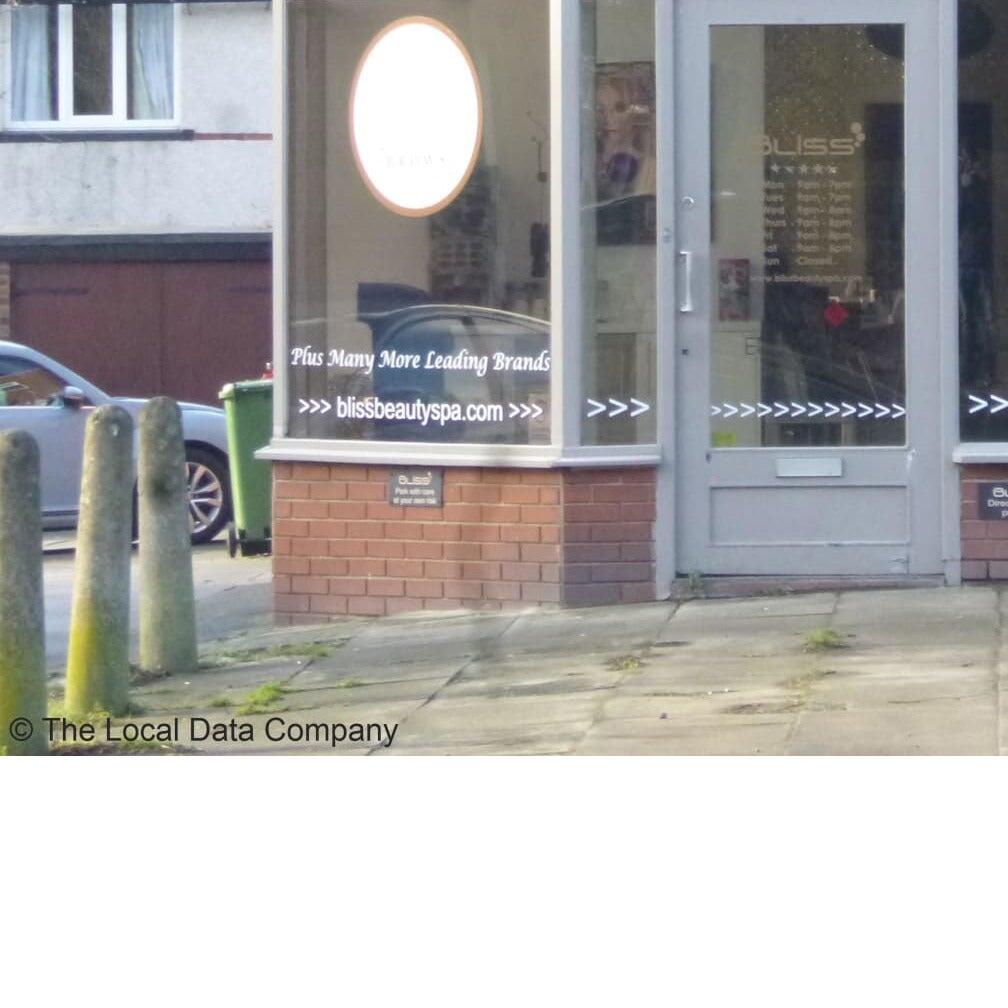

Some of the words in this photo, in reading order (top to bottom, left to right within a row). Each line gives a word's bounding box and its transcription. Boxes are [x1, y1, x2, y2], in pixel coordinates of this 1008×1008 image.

[290, 345, 324, 367] Plus
[327, 348, 376, 374] Many
[378, 349, 421, 369] More
[423, 348, 489, 377] Leading
[492, 349, 550, 372] Brands
[336, 395, 504, 426] blissbeautyspa.com
